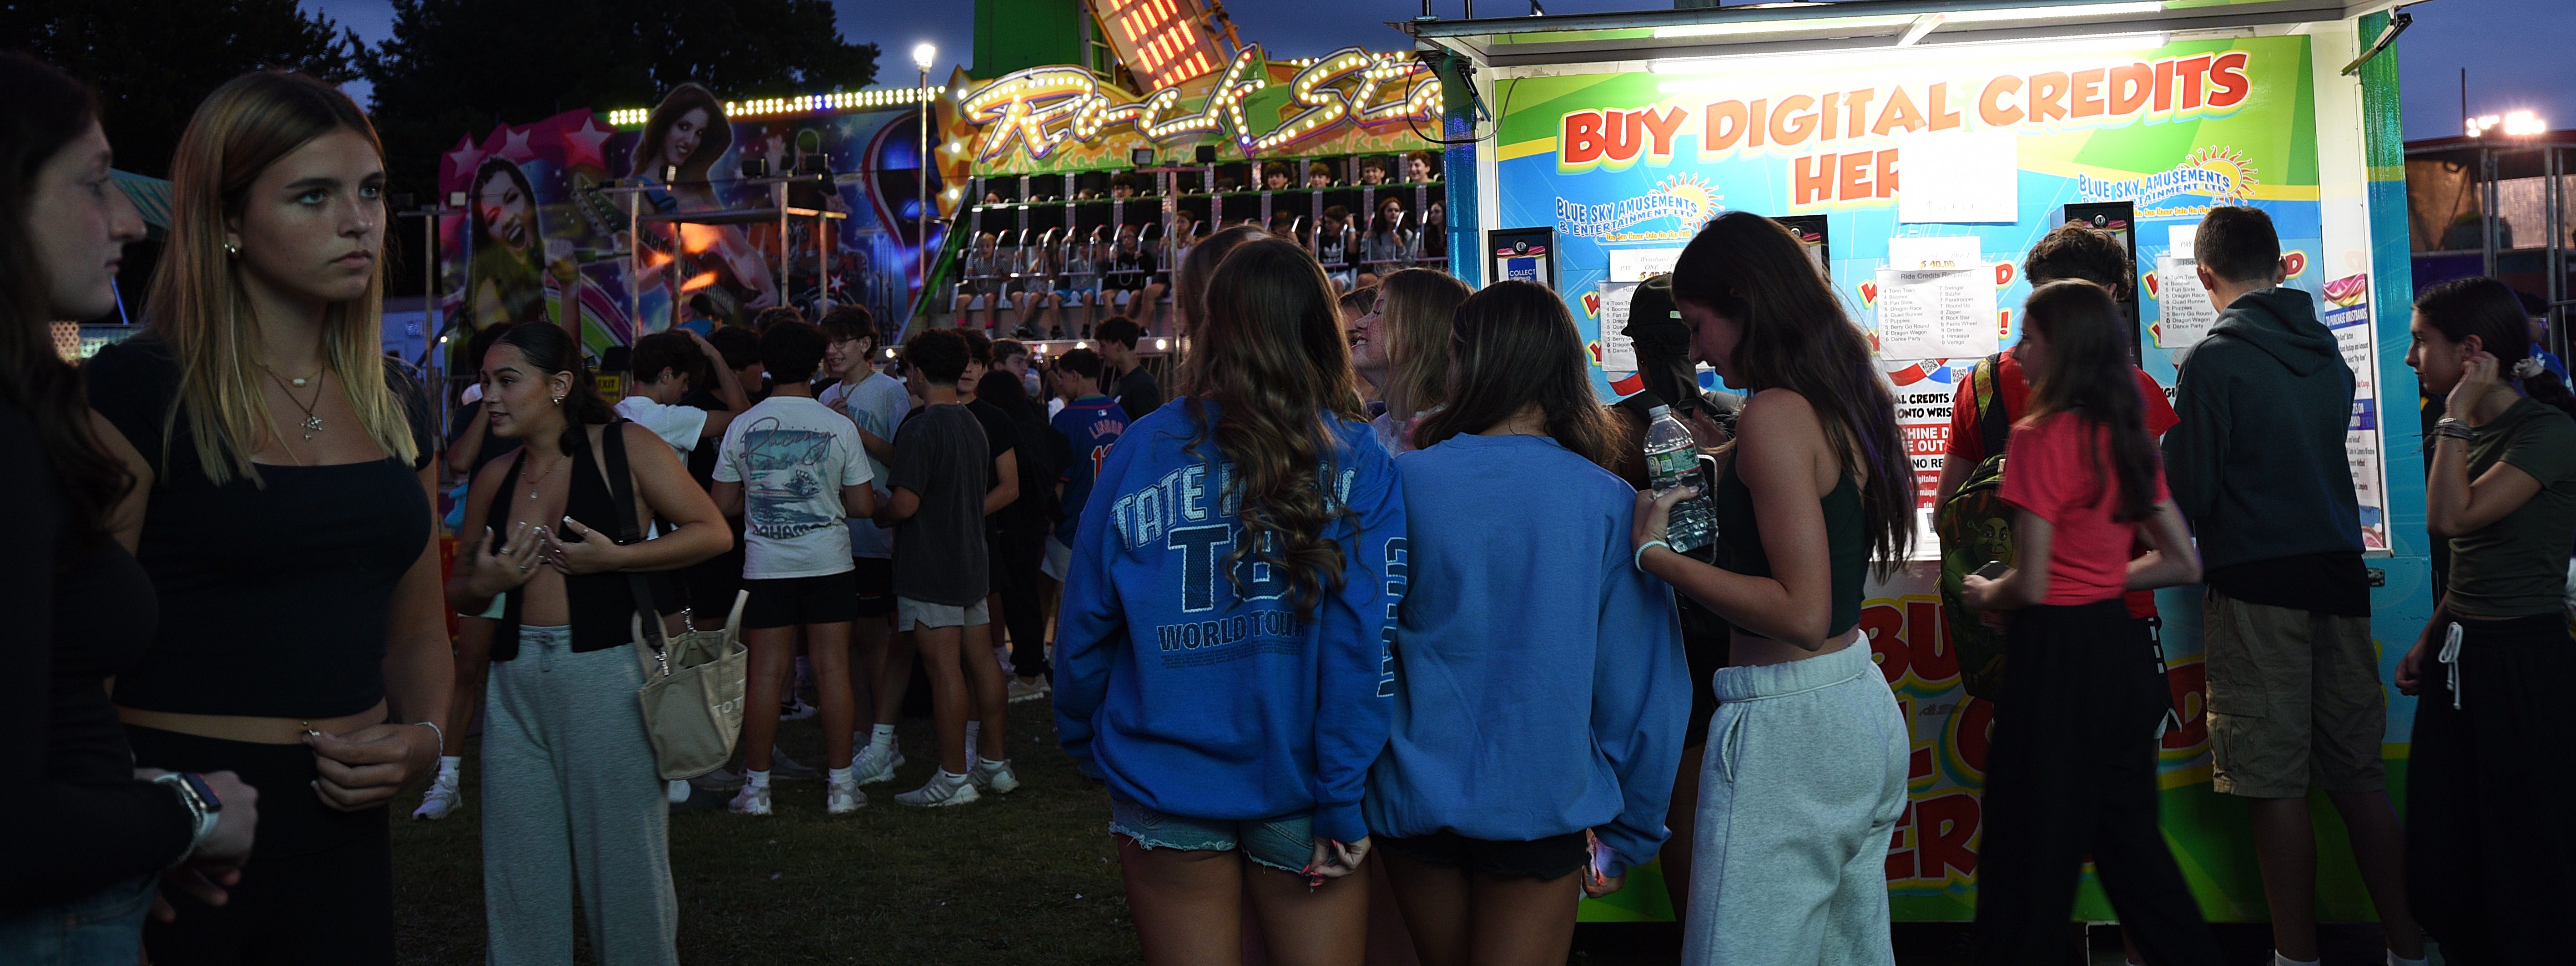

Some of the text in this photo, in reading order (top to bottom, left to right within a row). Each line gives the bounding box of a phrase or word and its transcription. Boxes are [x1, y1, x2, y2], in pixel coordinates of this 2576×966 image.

[959, 41, 1443, 163] Rock Sta
[1563, 52, 2250, 164] BUY DIGITAL CREDITS
[1794, 148, 1898, 205] HER
[2079, 169, 2231, 198] BLUE SKY AMUSEMENTS
[2205, 184, 2226, 192] LTD
[1557, 195, 1697, 223] BLUE SKY AMUSEMENTS
[1559, 208, 1693, 236] & ENTERTAINMENT LTD
[2326, 308, 2367, 327] TO PURCHASE WRISTBANDS
[1909, 393, 1949, 404] CREDITS
[2358, 403, 2364, 414] ON
[1897, 408, 1924, 418] ONTO
[740, 417, 837, 465] Racing
[1089, 420, 1124, 440] LINDOR
[1907, 427, 1938, 439] HINE
[1918, 440, 1945, 451] OUT
[1912, 459, 1927, 468] NO
[1110, 463, 1207, 552] TATE
[1156, 614, 1248, 652] WORLD
[1860, 603, 1961, 683] BU
[714, 696, 745, 718] TOT
